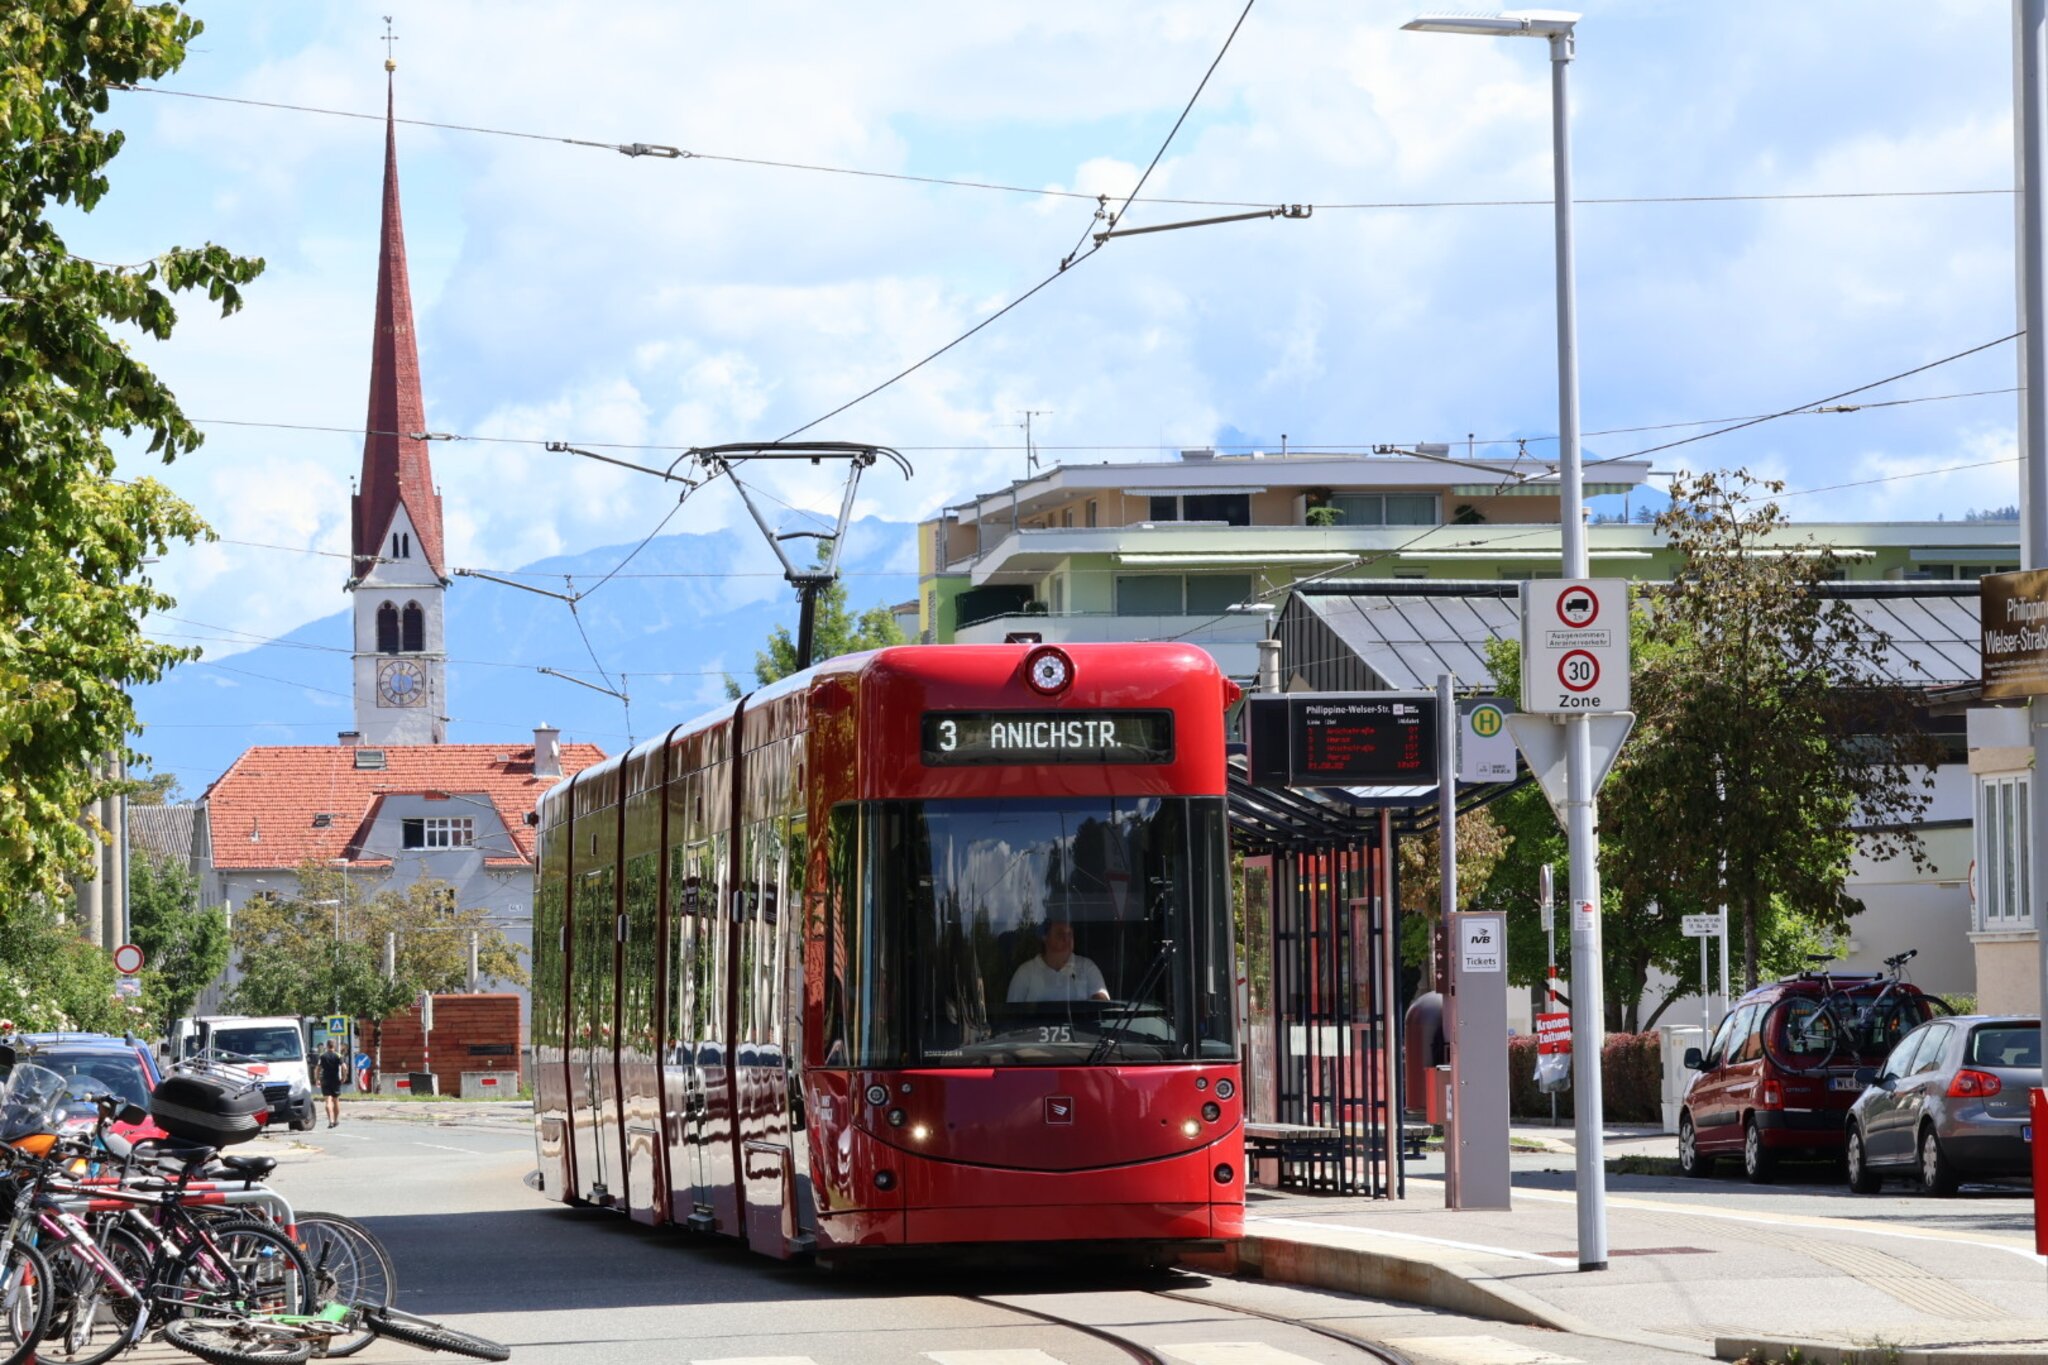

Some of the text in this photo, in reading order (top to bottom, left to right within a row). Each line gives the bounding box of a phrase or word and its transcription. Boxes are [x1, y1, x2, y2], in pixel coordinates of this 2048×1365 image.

[2006, 595, 2048, 625] Philippin
[1551, 632, 1605, 640] Ausgenommen
[1984, 625, 2048, 655] Welser-Straß
[1568, 661, 1590, 681] 30
[1559, 694, 1601, 708] Zone
[1306, 704, 1391, 716] Philippine-Welser-Str.
[1480, 713, 1494, 731] H
[939, 720, 1122, 751] 3 ANICHSTR.
[1471, 935, 1491, 944] IVB
[1466, 957, 1497, 966] Tickets
[1536, 1017, 1569, 1032] Kronen
[1039, 1026, 1070, 1042] 375
[1539, 1030, 1571, 1044] Zeitung
